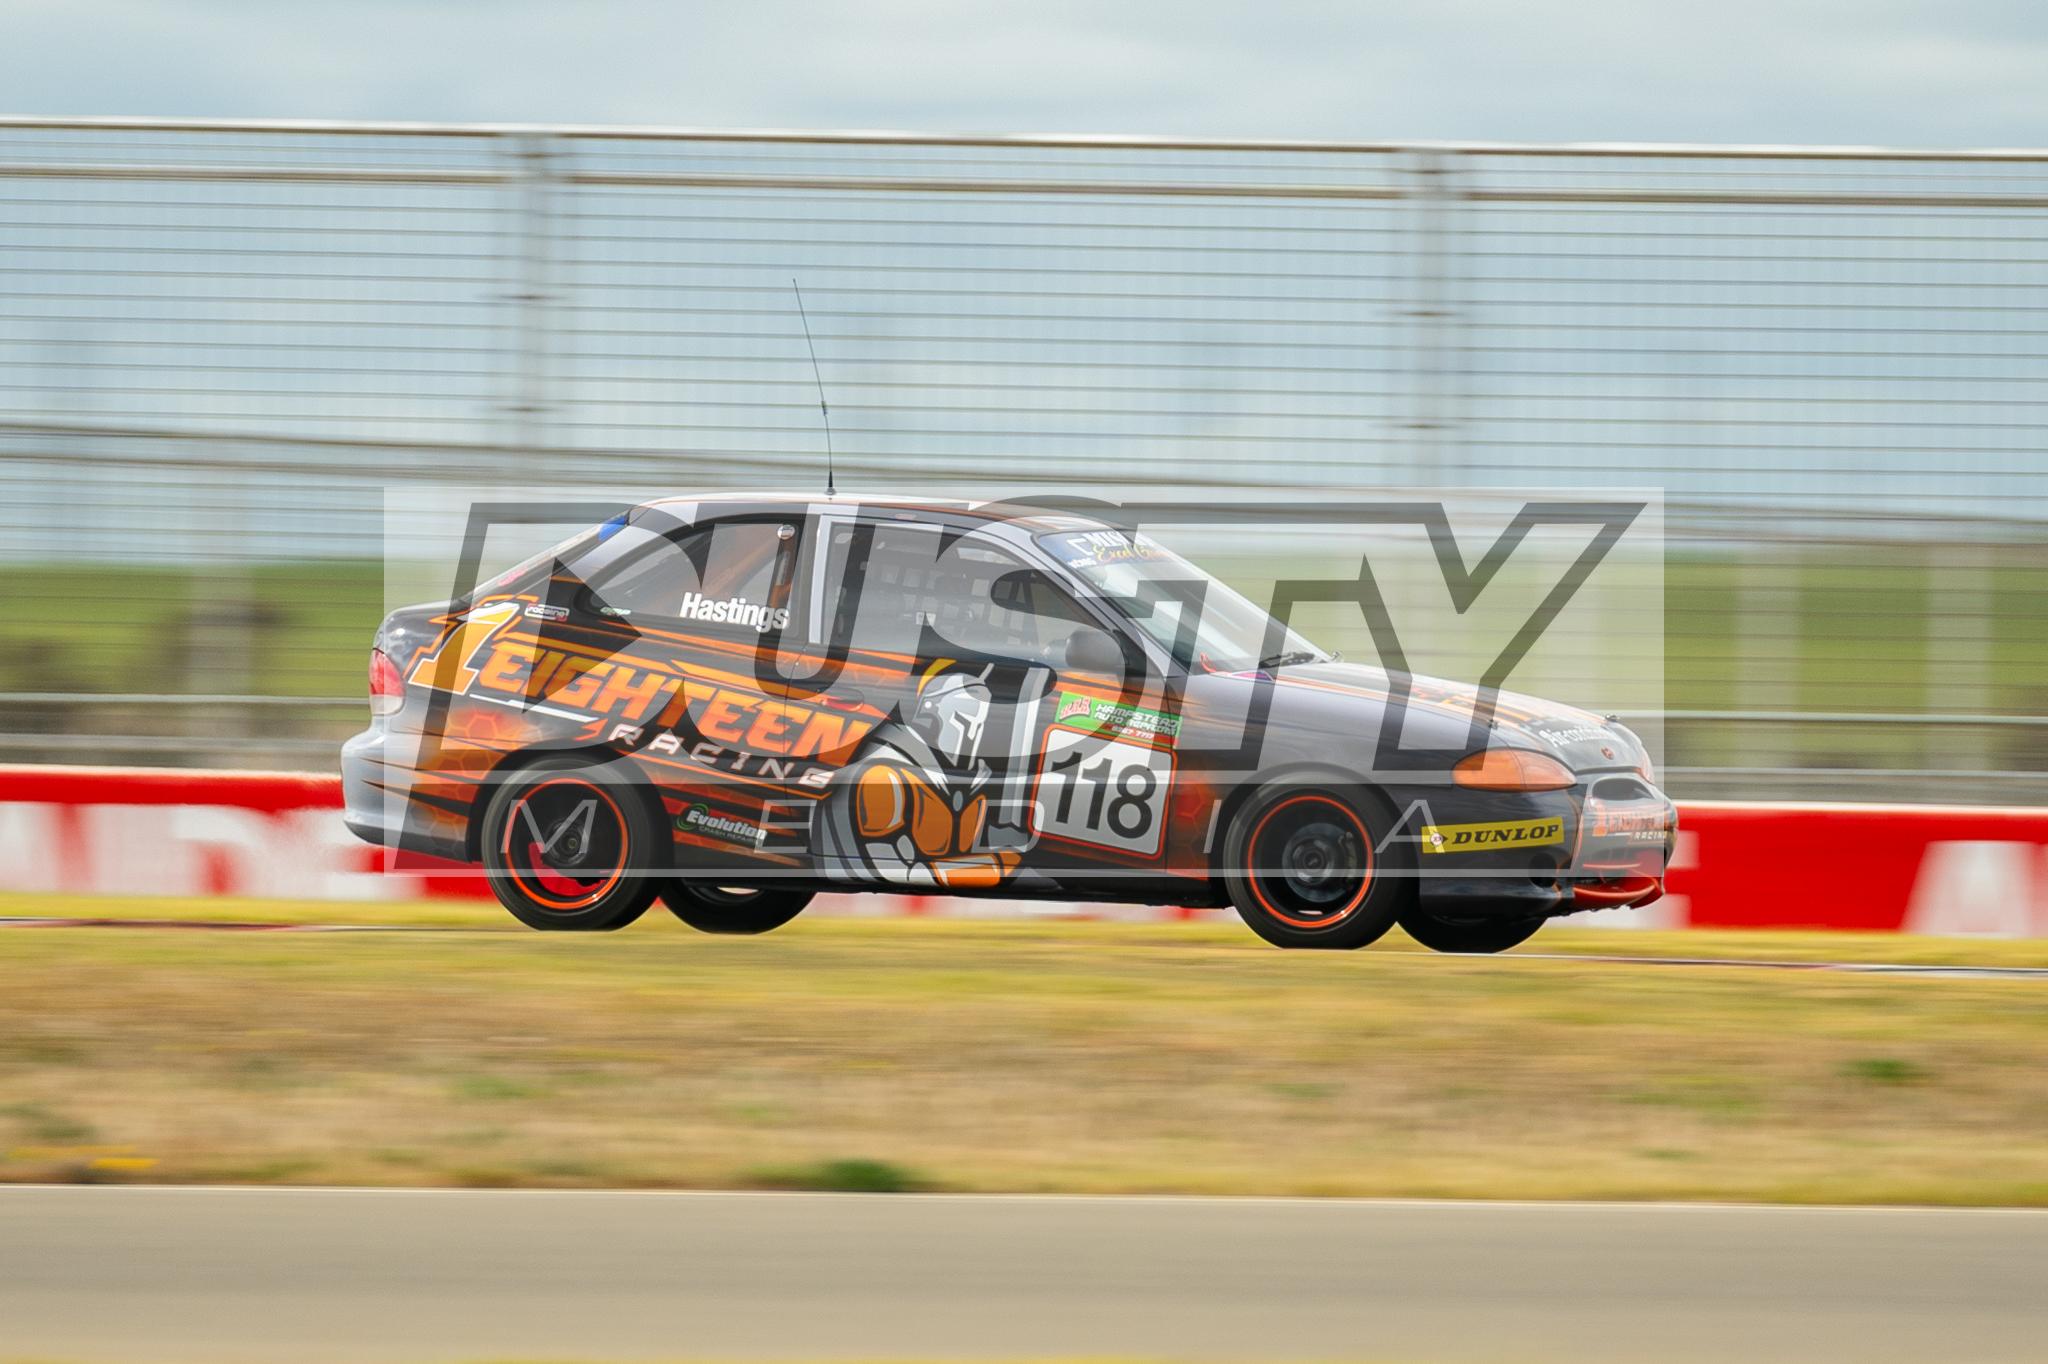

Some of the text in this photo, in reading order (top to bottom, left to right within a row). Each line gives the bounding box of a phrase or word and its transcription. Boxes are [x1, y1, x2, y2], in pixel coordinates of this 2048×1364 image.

[680, 592, 791, 633] Hastings
[479, 642, 875, 767] EIGHTEEN
[1094, 711, 1124, 724] AUTO
[608, 723, 837, 788] RACING
[1051, 750, 1157, 839] 118
[686, 809, 768, 840] Evolution
[1452, 824, 1559, 845] DUNLOP
